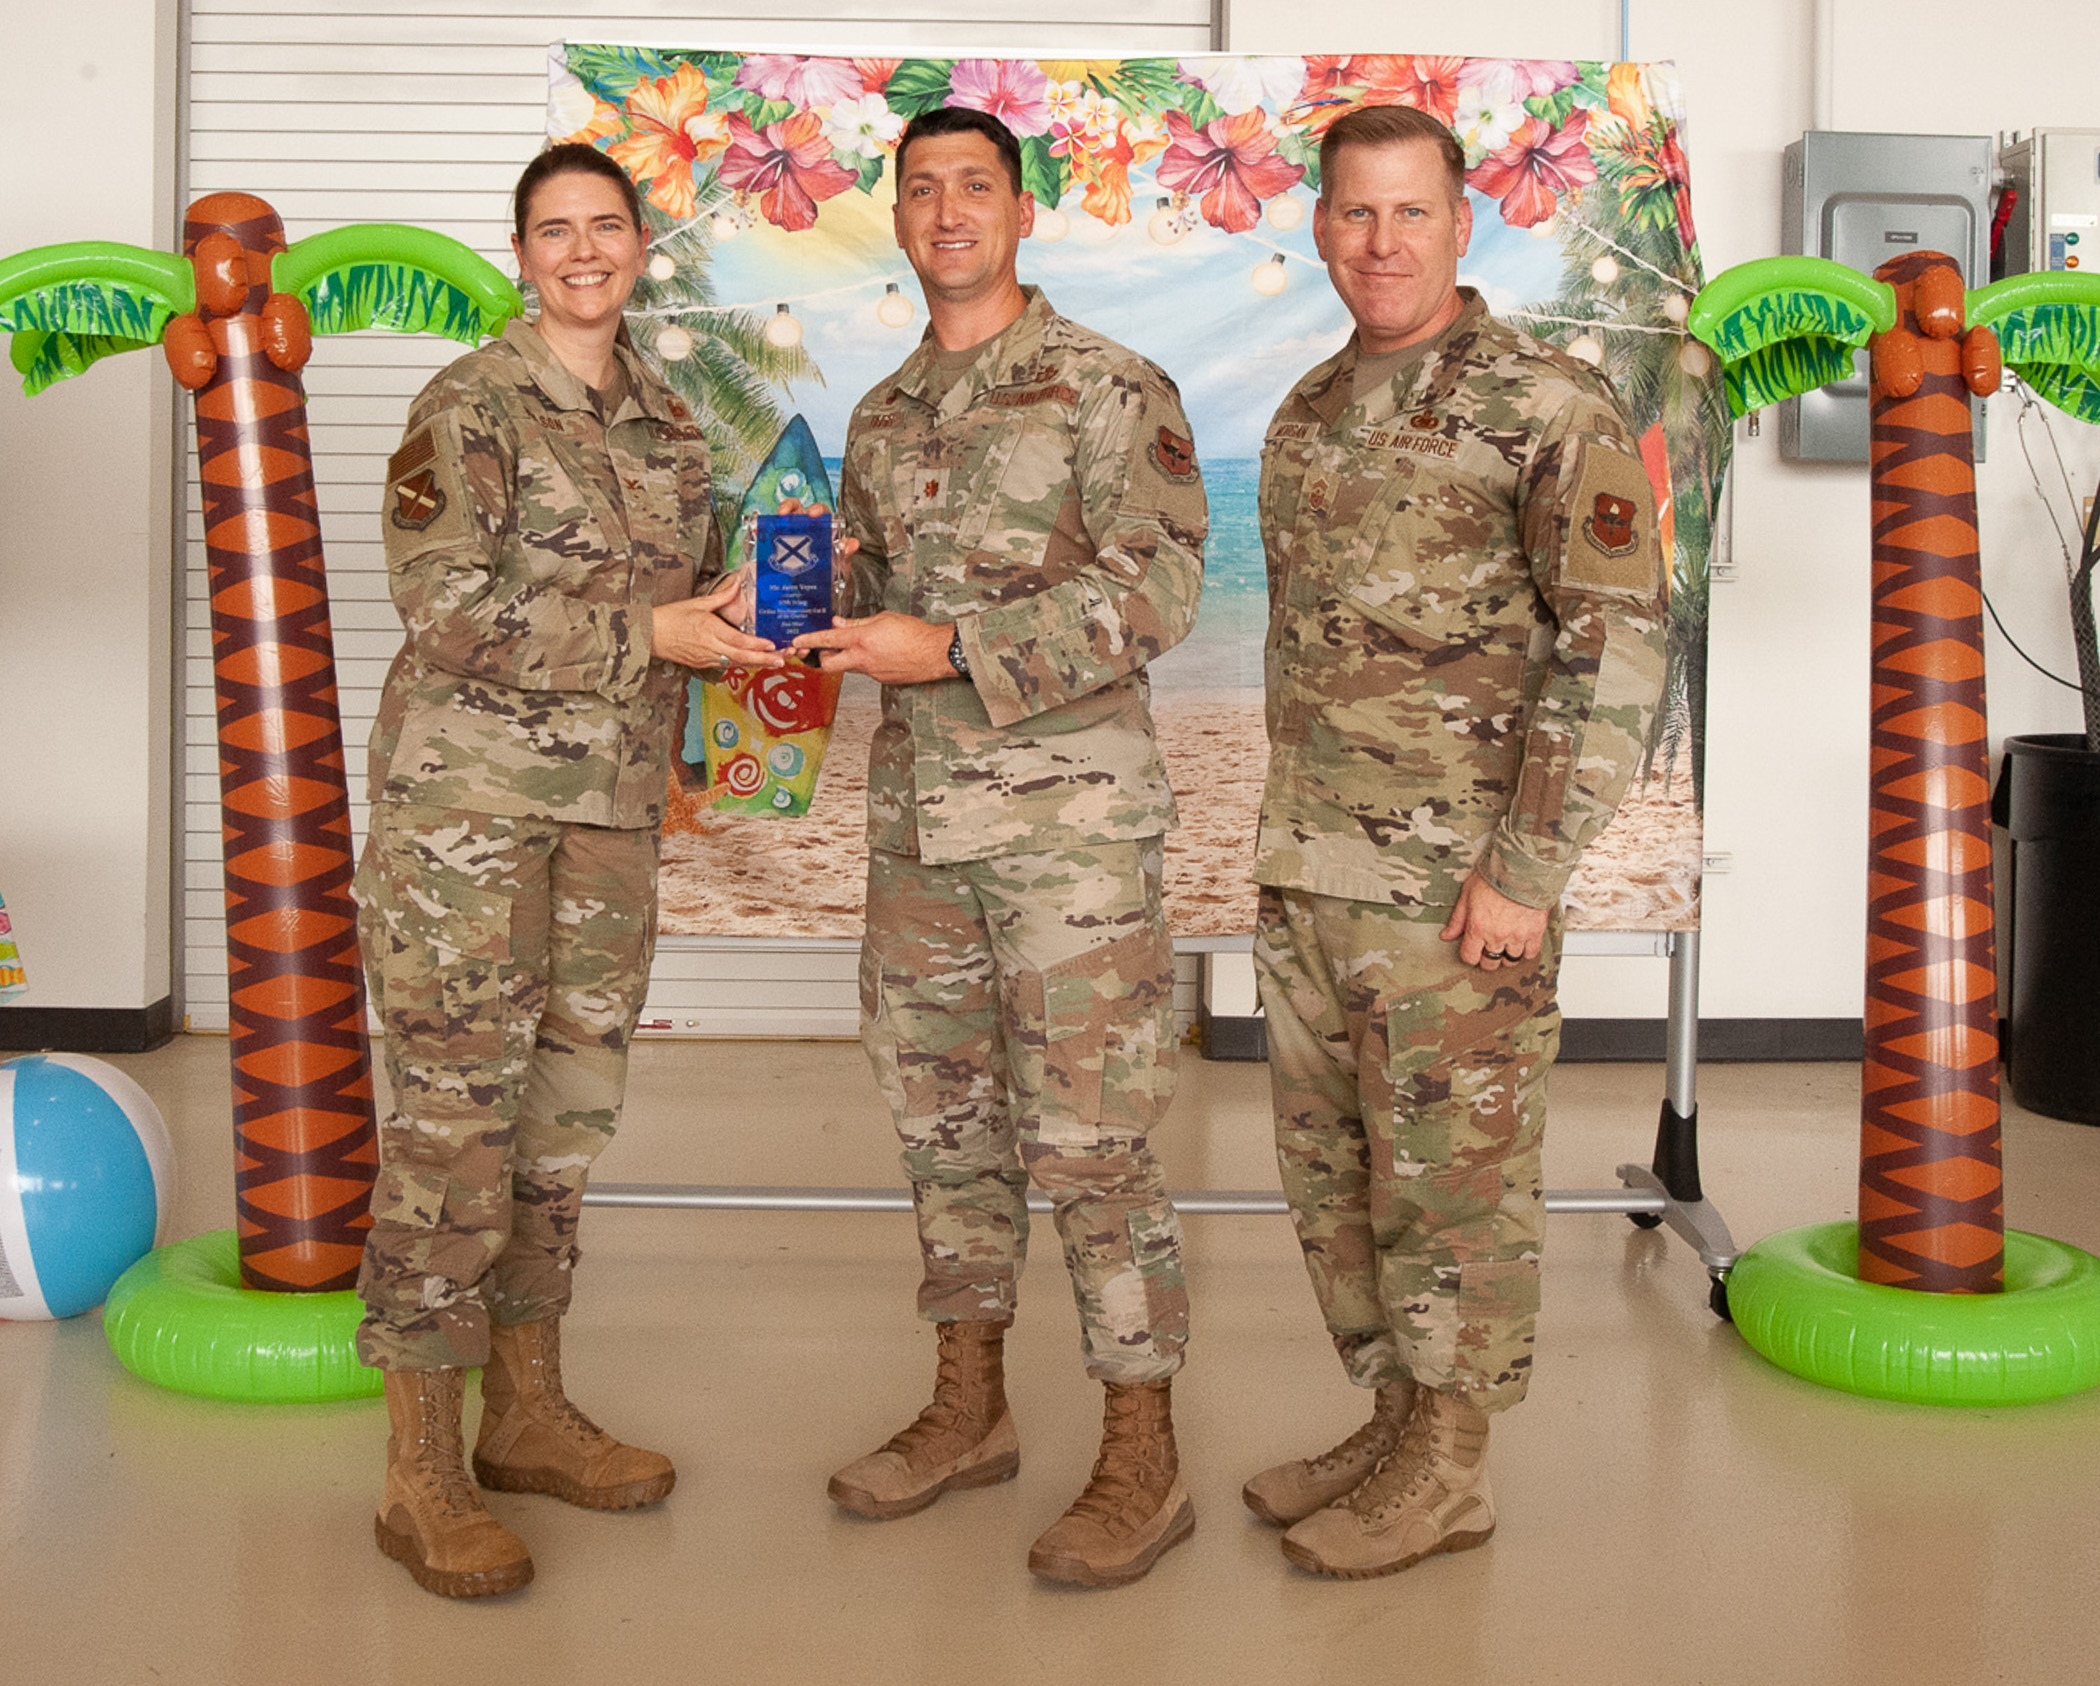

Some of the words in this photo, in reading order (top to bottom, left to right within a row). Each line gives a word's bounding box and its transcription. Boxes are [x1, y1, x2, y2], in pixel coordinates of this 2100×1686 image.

[1367, 431, 1389, 446] US
[1389, 434, 1412, 449] AIR
[1412, 436, 1458, 458] FORCE
